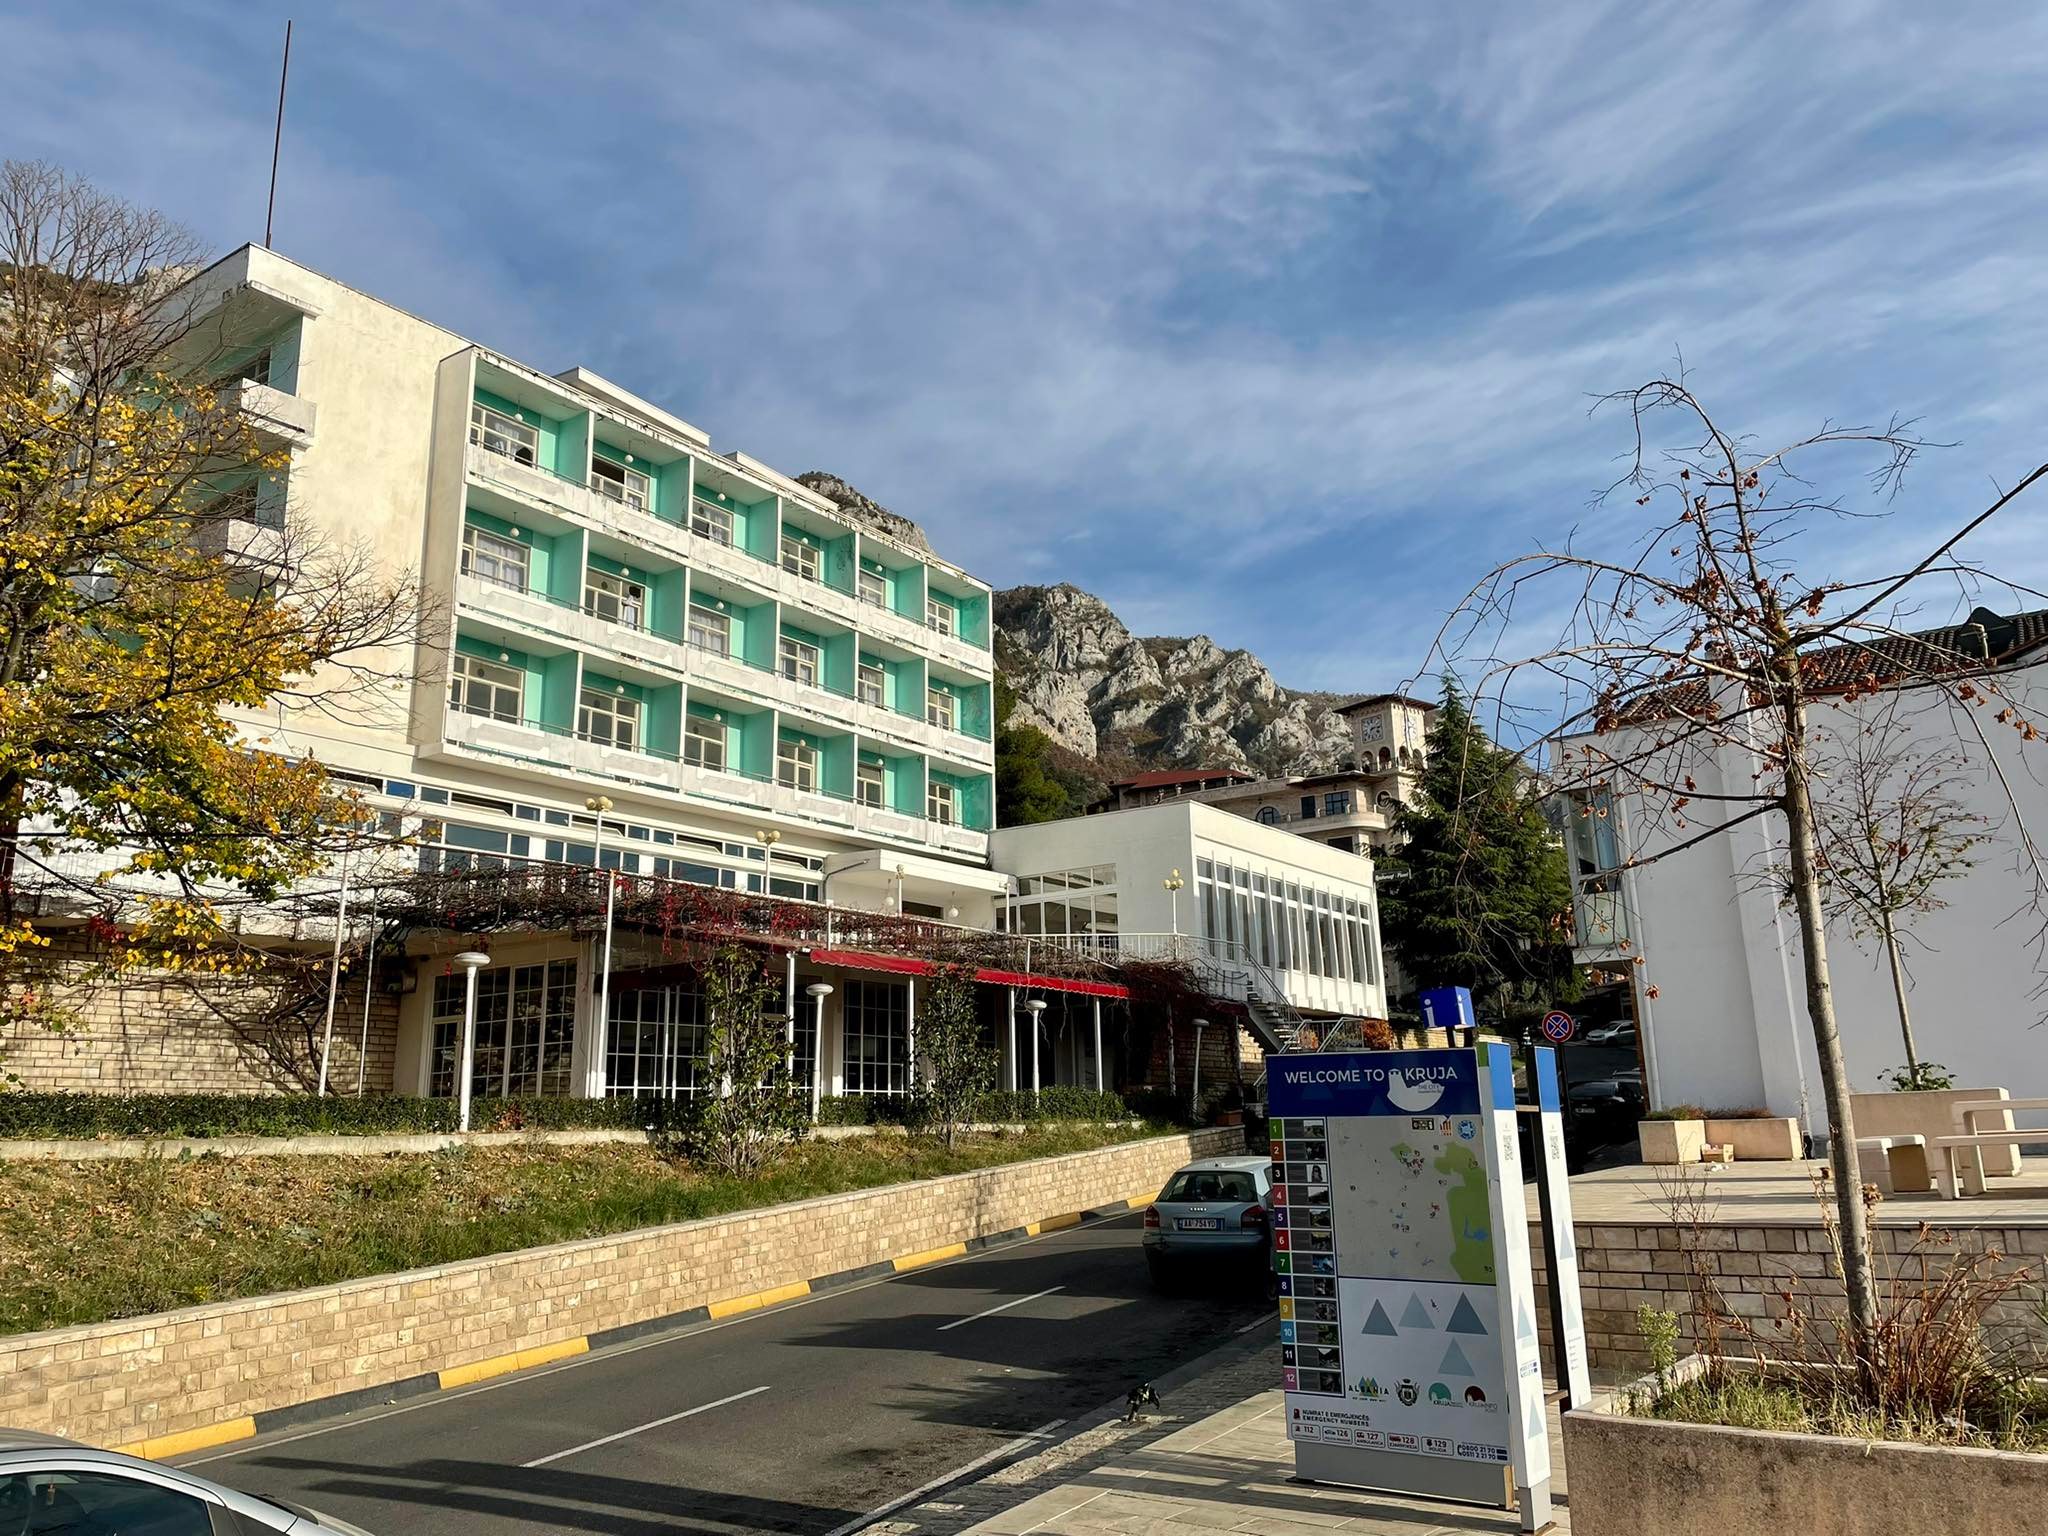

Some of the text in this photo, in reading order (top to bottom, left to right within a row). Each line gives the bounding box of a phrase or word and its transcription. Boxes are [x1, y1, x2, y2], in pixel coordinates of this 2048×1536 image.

[1285, 1066, 1458, 1084] WELCOME TO KRUJA
[1284, 1328, 1292, 1337] 10
[1285, 1350, 1293, 1359] 11
[1286, 1373, 1295, 1382] 12
[1348, 1384, 1389, 1395] ALBANIA
[1302, 1415, 1369, 1427] EMERGENCY NUMBERS
[1402, 1436, 1415, 1444] 128
[1434, 1440, 1447, 1448] 129
